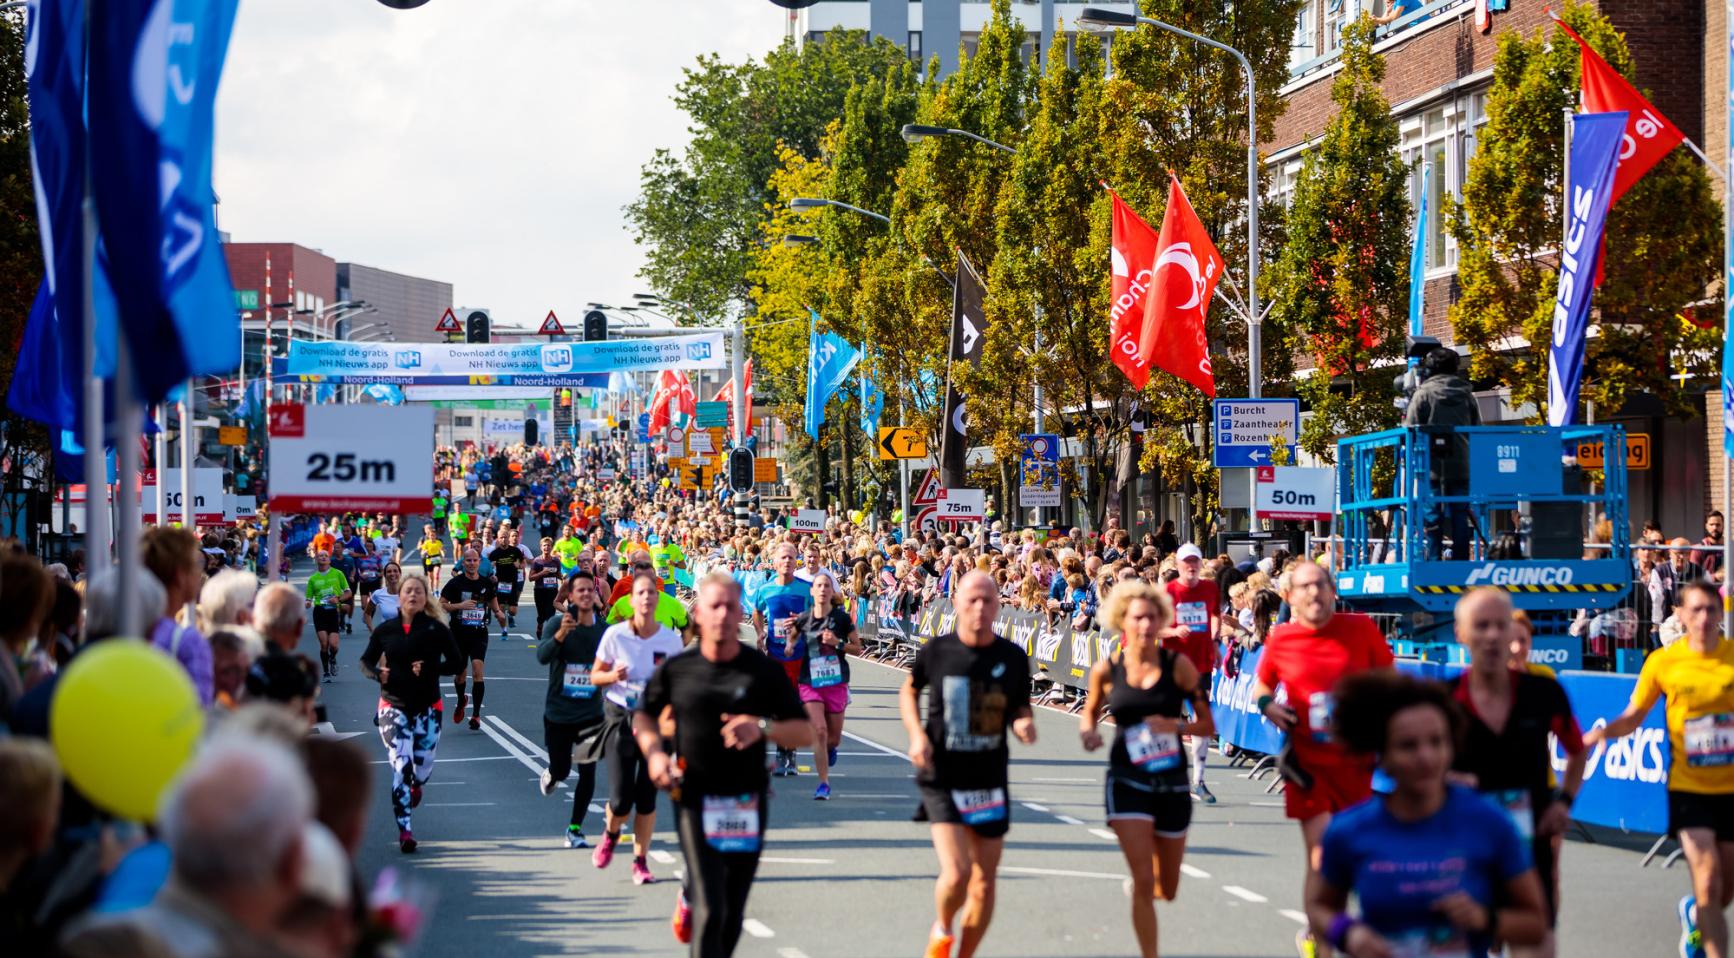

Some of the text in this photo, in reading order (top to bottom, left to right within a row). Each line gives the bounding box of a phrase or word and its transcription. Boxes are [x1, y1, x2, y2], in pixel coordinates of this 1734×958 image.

[1553, 185, 1594, 347] asics
[300, 346, 388, 358] Download de gratis
[594, 342, 680, 354] Download de gratis
[688, 343, 711, 358] NH
[397, 351, 420, 366] NH
[449, 349, 538, 358] Download de gratis
[545, 350, 570, 364] NH
[319, 359, 388, 370] NH Nieuws app
[468, 361, 483, 369] NH
[485, 361, 519, 369] Nieuws
[613, 355, 681, 365] NH Nieuws app
[344, 375, 414, 384] Noord-Holland
[514, 377, 584, 387] Noord-Holland
[1223, 406, 1266, 415] P Burcht
[493, 422, 507, 430] Zet
[1233, 420, 1293, 428] Zaantheatr
[1233, 433, 1279, 442] Rozenhf
[306, 451, 396, 482] 25m
[1271, 490, 1315, 506] 50m
[236, 506, 251, 514] 0m
[946, 503, 972, 513] 75m
[795, 519, 819, 528] 100m
[1491, 566, 1573, 585] GUNCO
